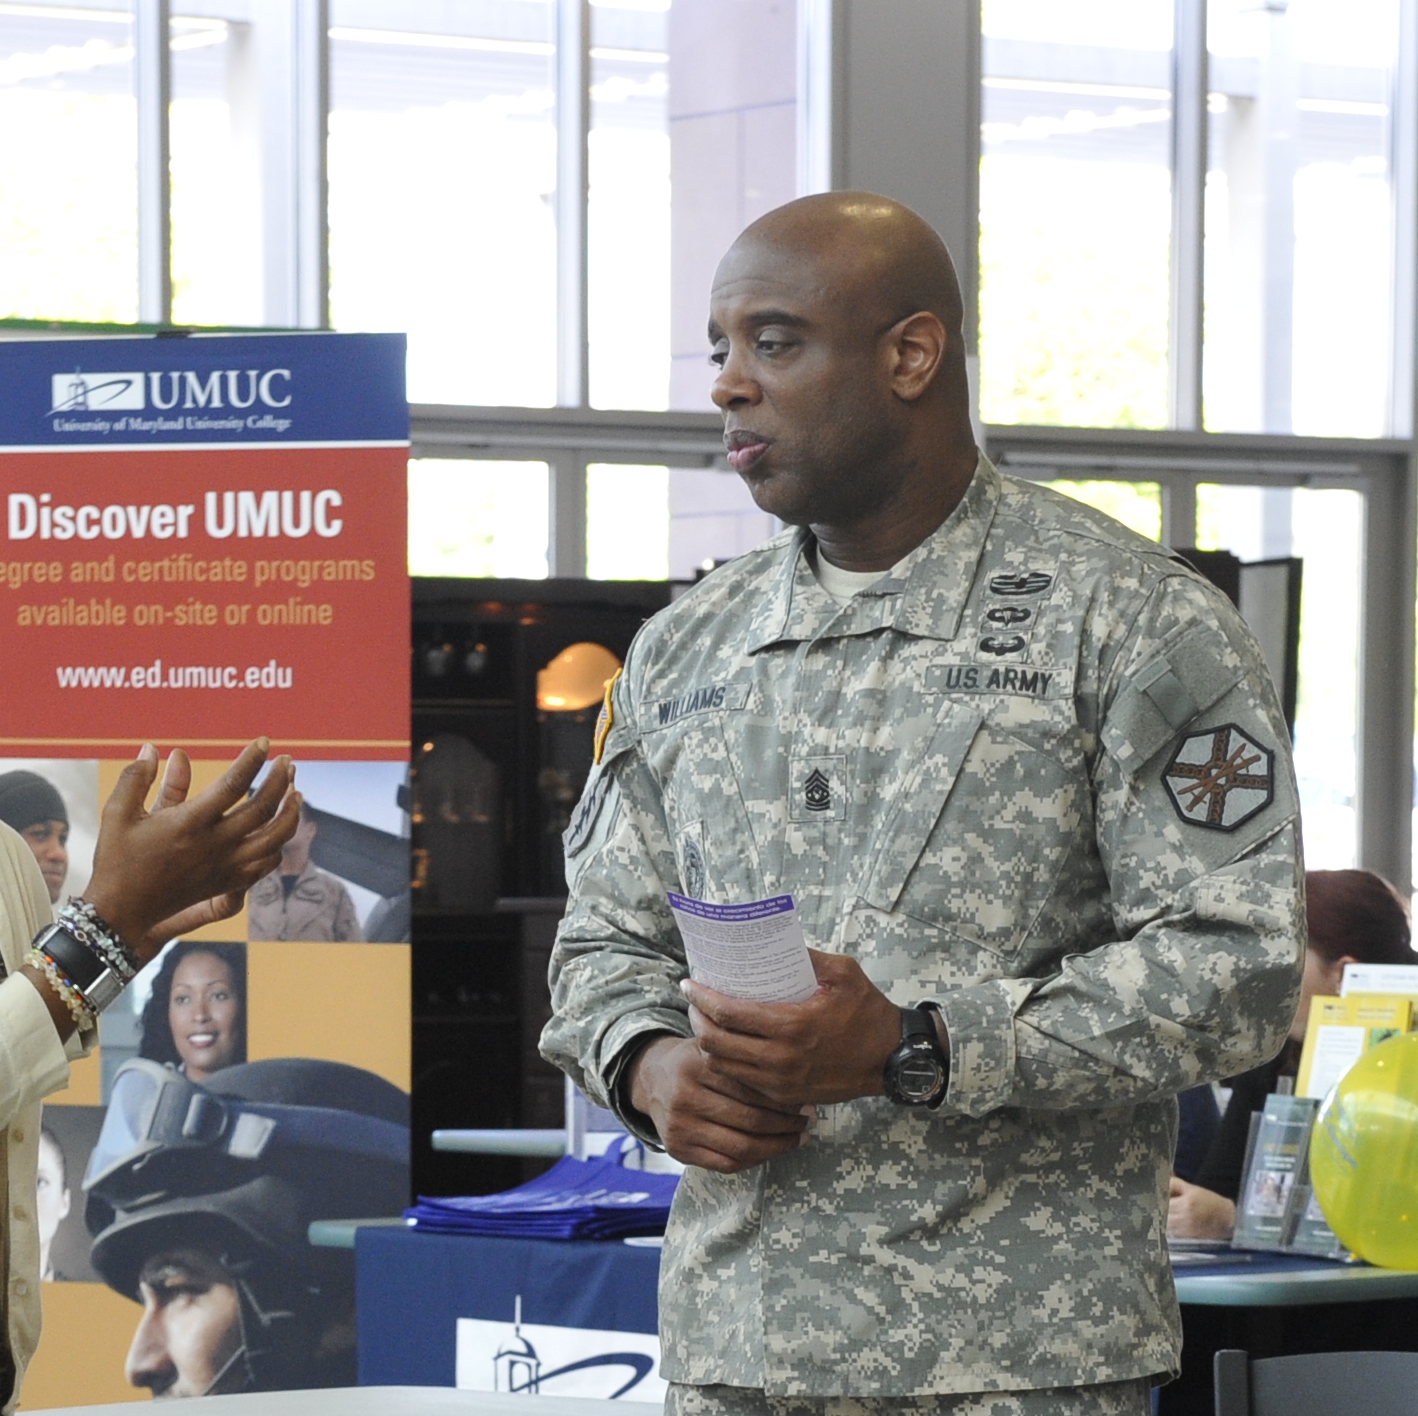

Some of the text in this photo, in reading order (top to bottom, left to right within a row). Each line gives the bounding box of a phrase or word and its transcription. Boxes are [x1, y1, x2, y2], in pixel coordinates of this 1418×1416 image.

[147, 368, 292, 410] UMUC
[53, 414, 292, 435] University of Maryland University College
[8, 489, 344, 541] Discover UMUC
[70, 554, 115, 583] and
[122, 553, 247, 583] certificate
[254, 557, 376, 589] programs
[16, 596, 333, 627] available on-site or online
[56, 659, 293, 689] www.ed.umuc.edu
[945, 667, 1053, 695] U.S. ARMY
[659, 686, 726, 725] WILLIAMS
